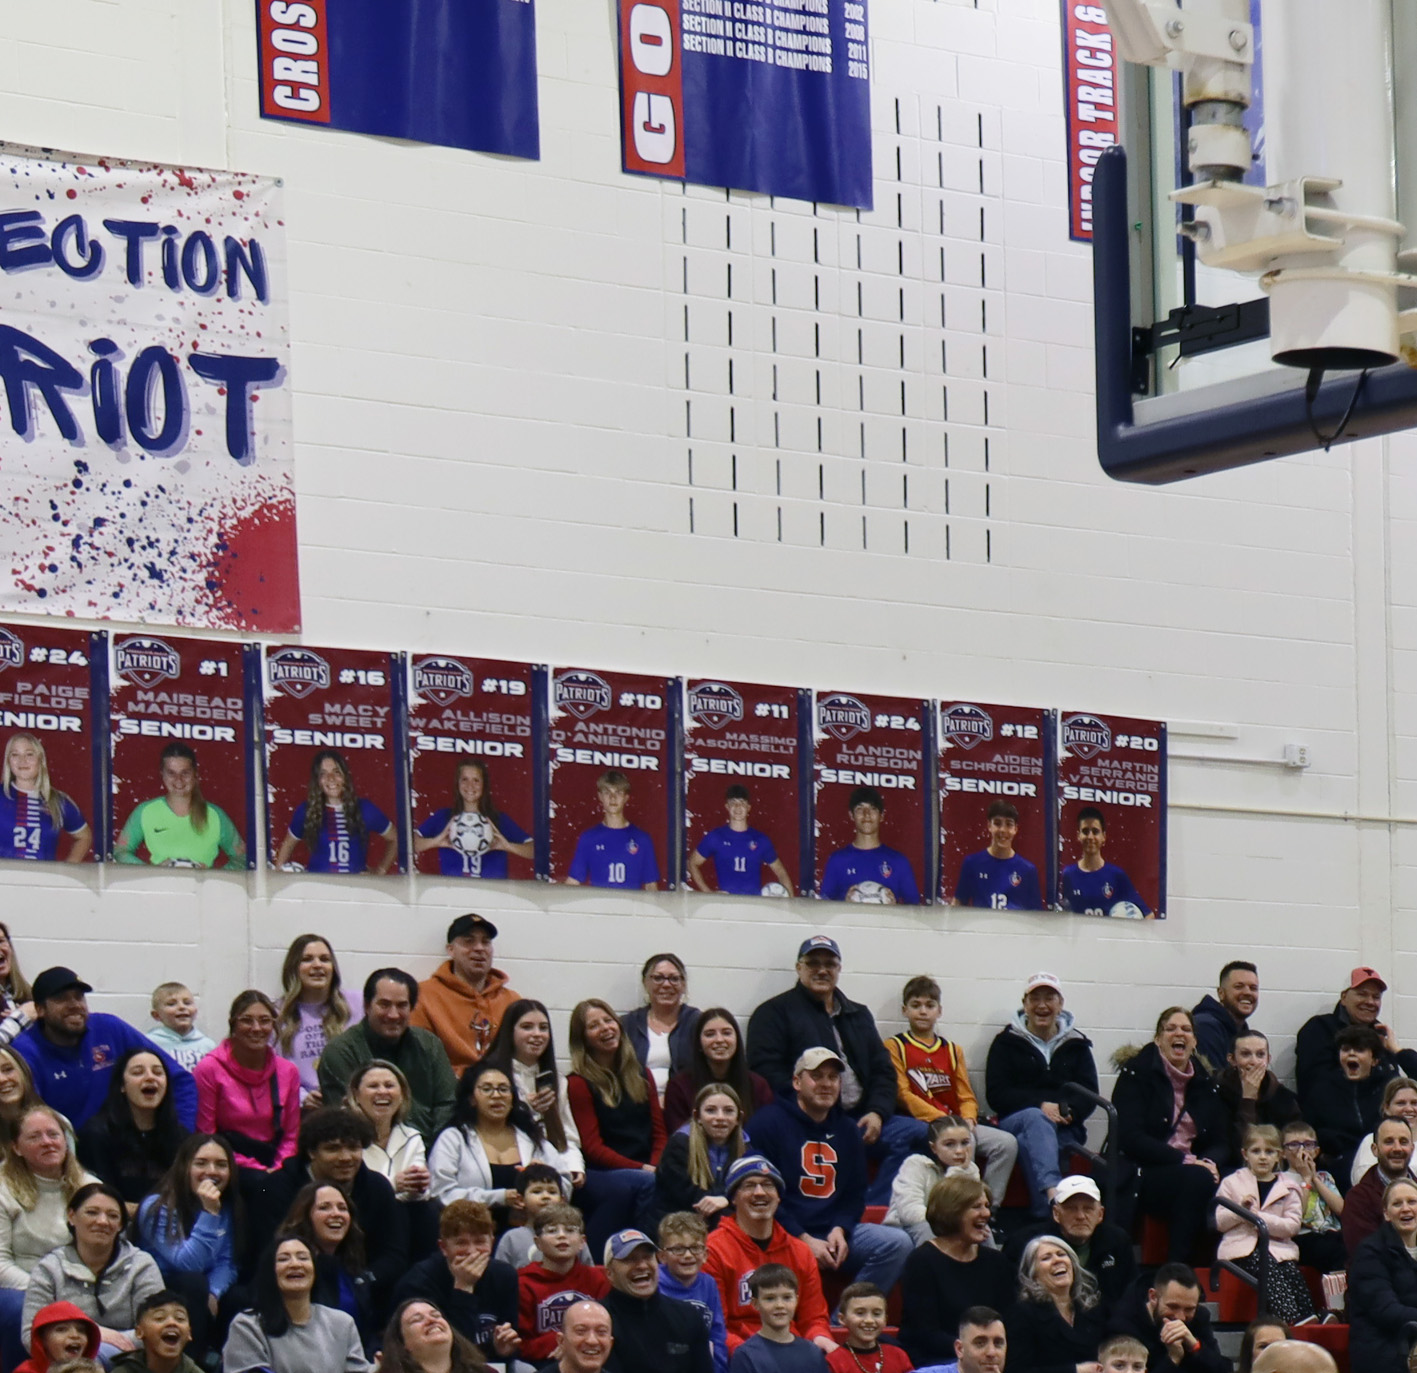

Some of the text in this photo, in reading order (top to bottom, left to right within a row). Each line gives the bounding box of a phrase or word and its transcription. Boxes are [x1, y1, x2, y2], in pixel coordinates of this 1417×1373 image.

[683, 13, 867, 61] SECTION II CLASS B CHAMPIONS 2011
[683, 34, 868, 79] SECTION II CLASS B CHAMPIONS 2015
[1075, 29, 1115, 122] TRACK
[29, 646, 88, 667] #24
[116, 651, 179, 677] PATRIOTS
[199, 660, 229, 677] #1
[338, 669, 386, 687] #16
[481, 678, 527, 696] #19
[16, 682, 90, 699] PAIGE
[136, 691, 243, 709] MAIREAD
[619, 692, 663, 710] #10
[127, 702, 243, 721] MARSDEN
[323, 702, 390, 717] MACY
[441, 709, 531, 726] ALLISON
[754, 703, 790, 719] #11
[0, 711, 82, 732] NIOR
[308, 714, 386, 728] SWEET
[409, 717, 531, 736] WAKEFIELD
[874, 714, 922, 731] #24
[118, 719, 236, 743] SENIOR
[273, 729, 385, 750] SENIOR
[574, 722, 666, 740] ANTONIO
[725, 732, 797, 746] MASSIMO
[1000, 723, 1039, 740] #12
[416, 735, 524, 758] SENIOR
[685, 738, 794, 755] PASQUARELLI
[1115, 734, 1159, 751] #20
[556, 748, 660, 772] SENIOR
[842, 744, 922, 760] LANDON
[992, 754, 1043, 767] AIDEN
[691, 758, 791, 779] SENIOR
[836, 754, 918, 770] RUSSOM
[951, 760, 1043, 776] SCHRODER
[1097, 758, 1159, 773] MARTIN
[820, 769, 916, 790] SENIOR
[1068, 774, 1159, 792] VALVERDE
[1079, 766, 1159, 783] SERRANO
[945, 777, 1037, 797] SENIOR
[1063, 787, 1152, 808] SENIOR
[13, 827, 41, 850] 24
[328, 841, 349, 865] 16
[800, 1140, 838, 1199] S
